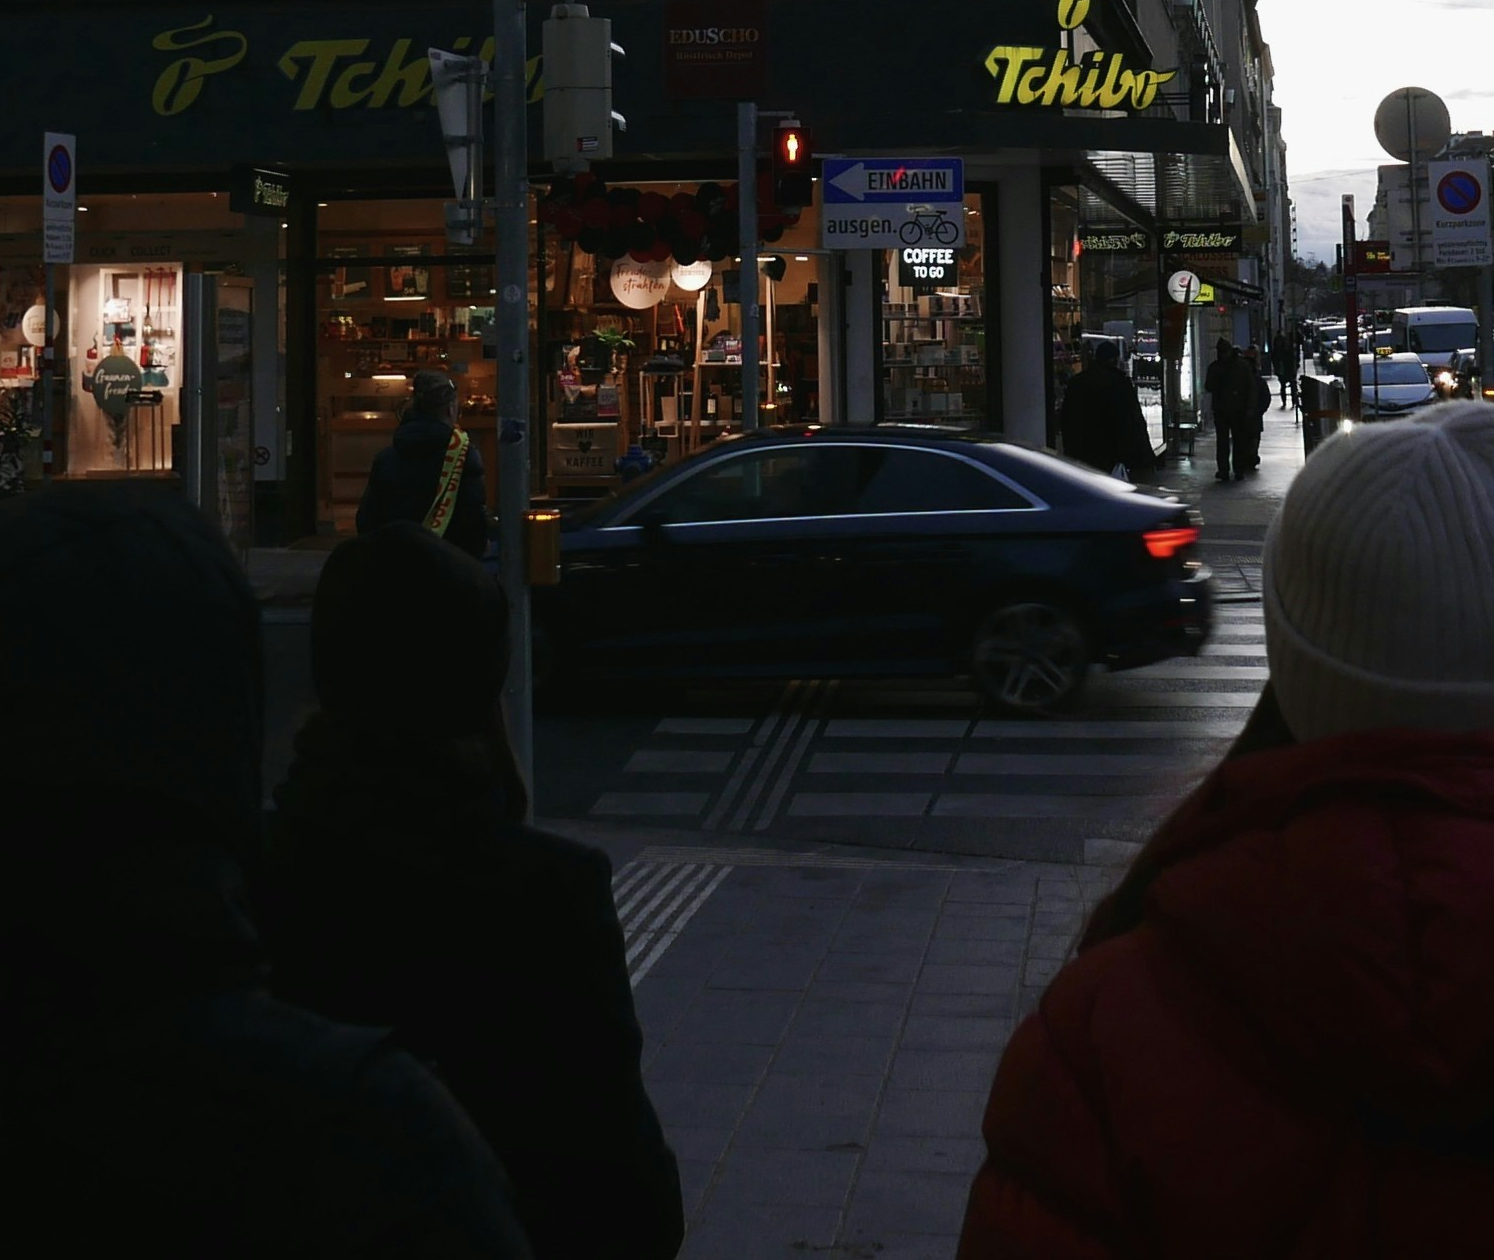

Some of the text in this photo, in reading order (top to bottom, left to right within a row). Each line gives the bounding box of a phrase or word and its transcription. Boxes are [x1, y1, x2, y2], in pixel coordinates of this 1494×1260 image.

[669, 27, 760, 45] EDUSCHO
[276, 37, 545, 111] Tch
[984, 45, 1178, 110] Tchibo
[868, 171, 947, 191] EINBAHN
[827, 219, 897, 238] ausgen.
[903, 248, 954, 265] COFFEE
[913, 266, 945, 279] TO GO
[566, 456, 604, 467] KAFFEE
